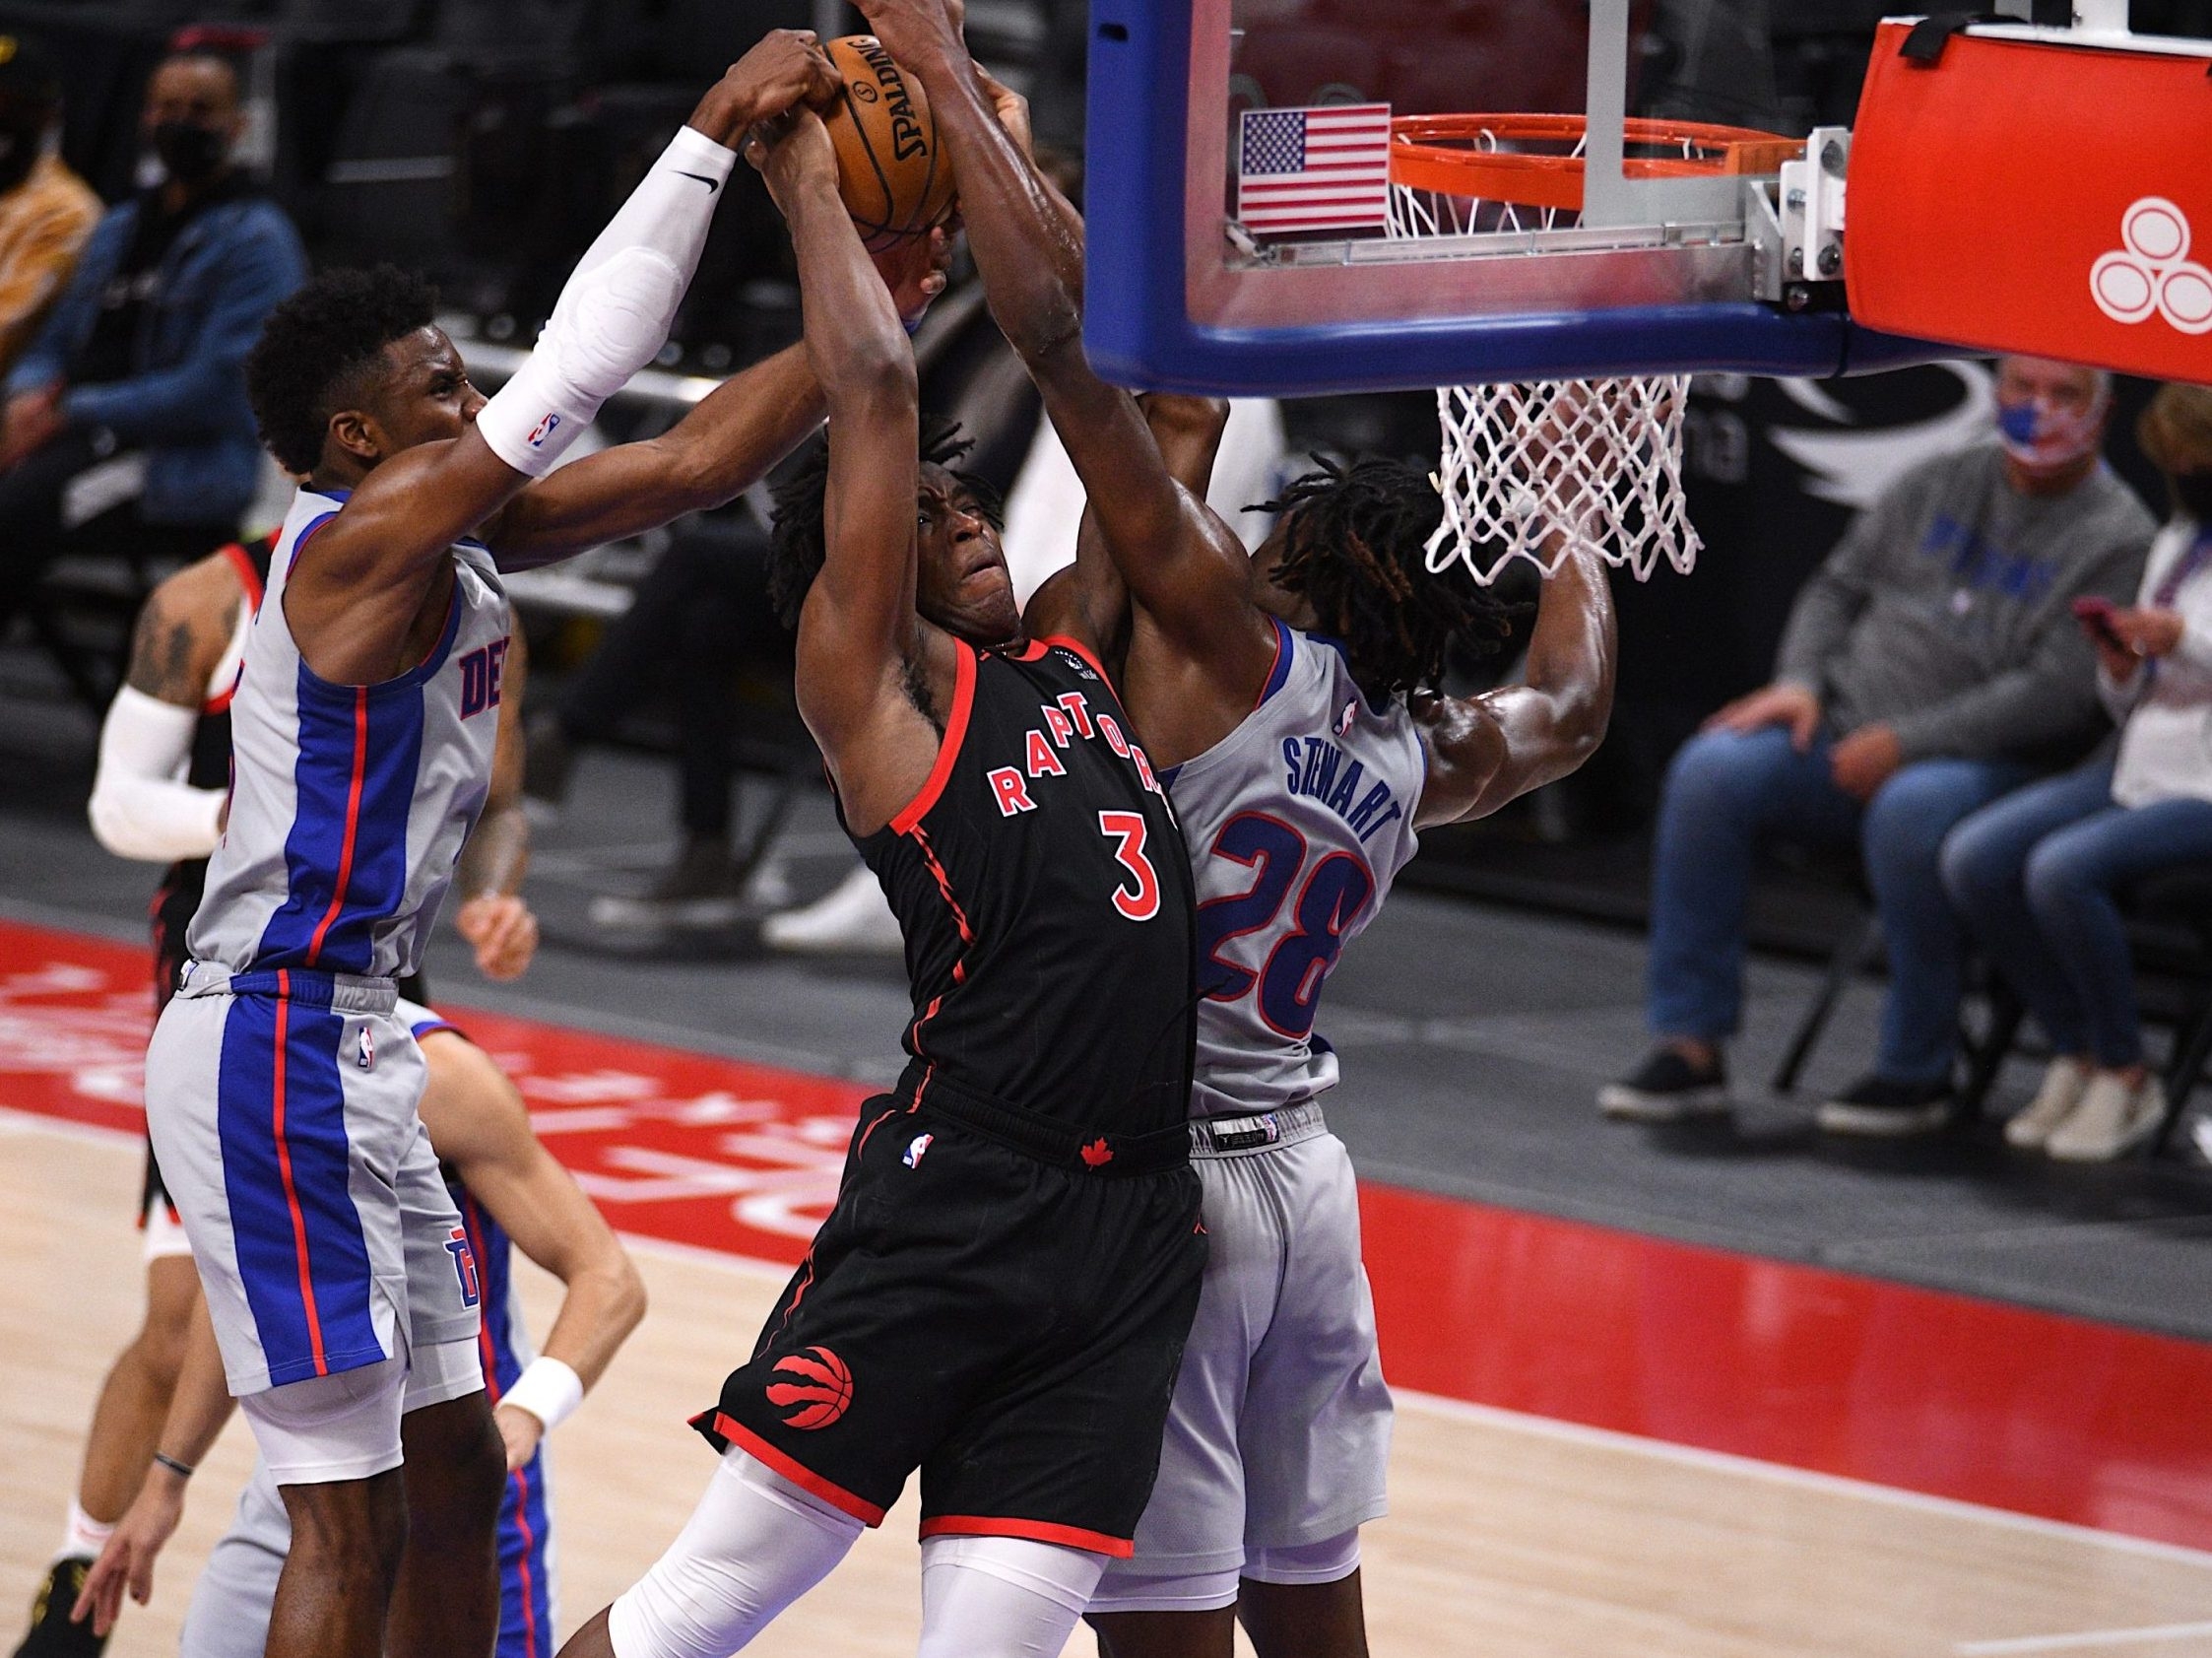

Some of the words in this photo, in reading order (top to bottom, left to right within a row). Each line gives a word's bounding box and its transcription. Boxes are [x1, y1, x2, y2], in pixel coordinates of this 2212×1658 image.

[847, 39, 928, 161] SPALDING
[458, 636, 511, 721] DE
[987, 692, 1178, 831] RAPTOR
[1282, 736, 1401, 844] STEWART
[1098, 811, 1161, 922] 3
[1197, 810, 1375, 1040] 28
